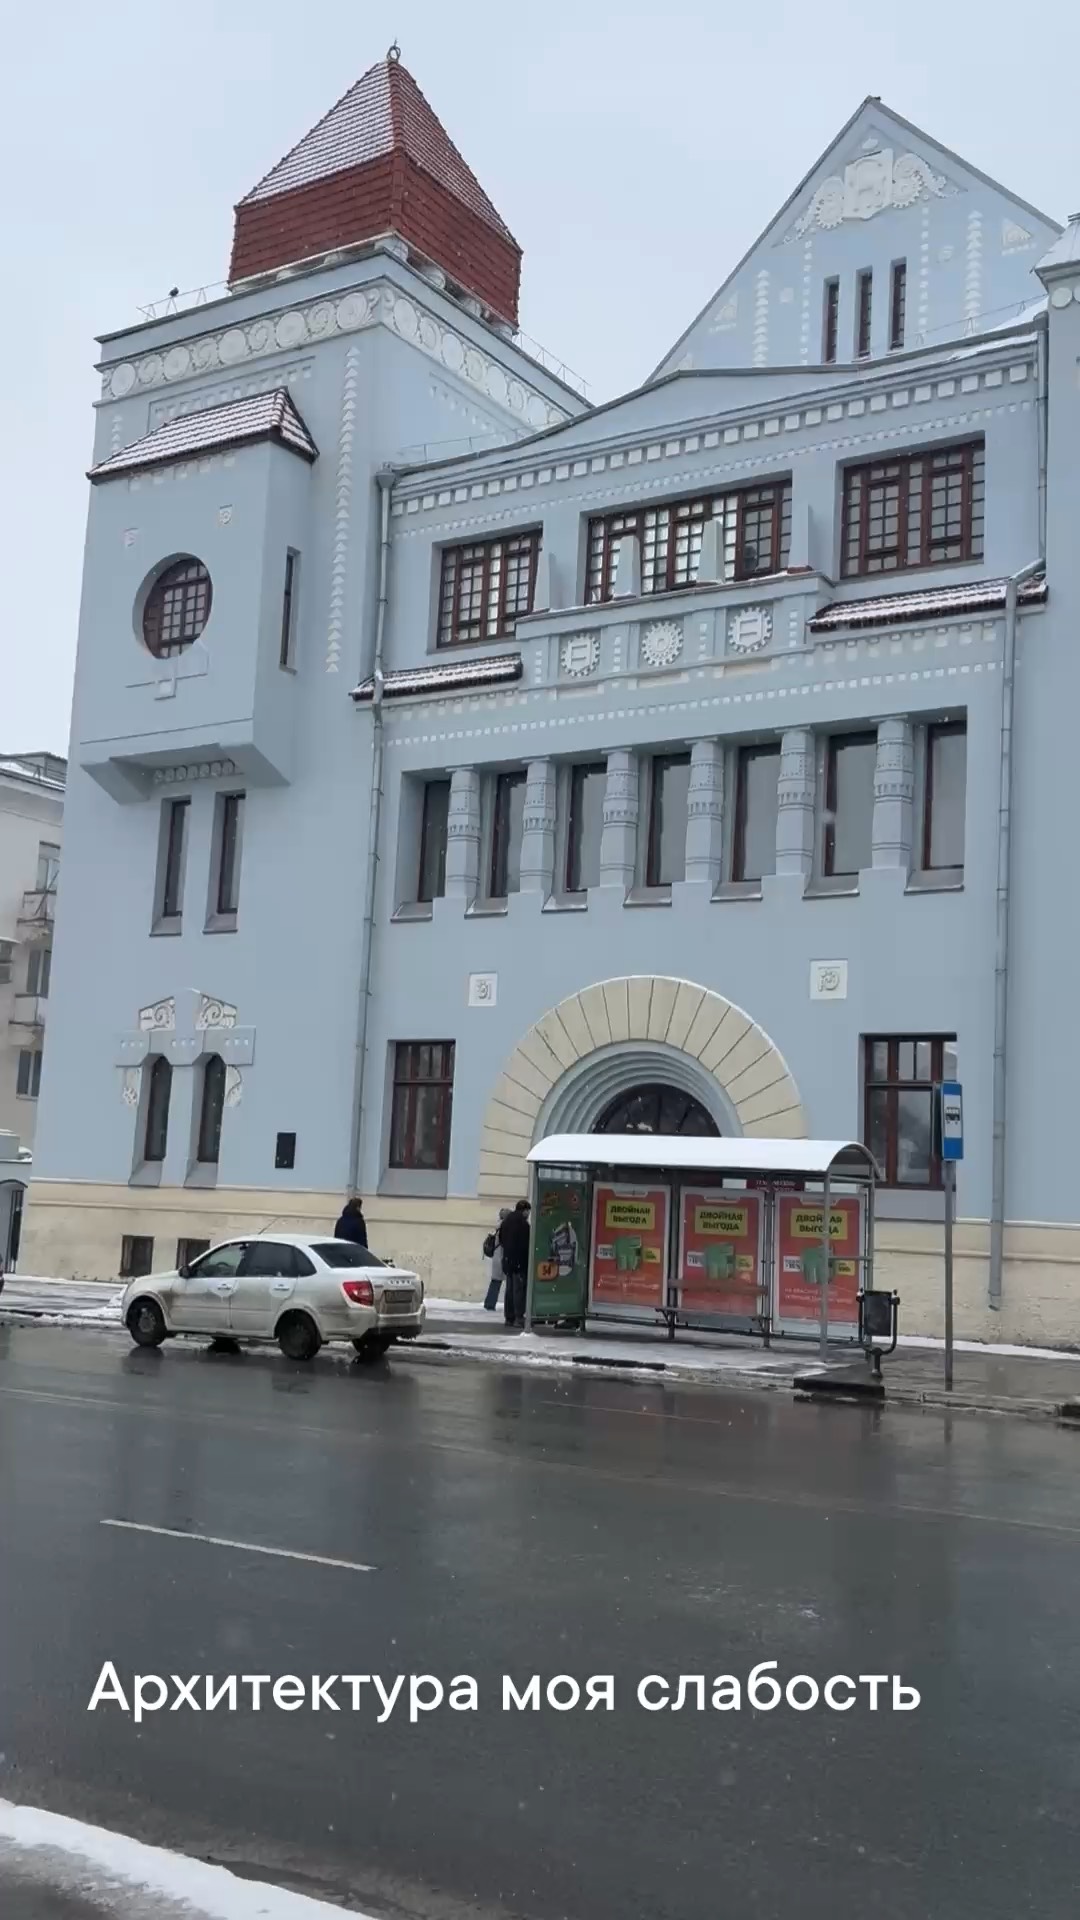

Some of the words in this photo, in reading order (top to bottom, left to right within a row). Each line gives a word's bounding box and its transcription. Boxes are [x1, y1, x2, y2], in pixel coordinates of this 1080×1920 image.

[610, 1204, 650, 1214] ДВОЙНАЯ
[612, 1215, 647, 1224] ВЫГОДА
[699, 1210, 744, 1222] ДВОЙНАЯ
[795, 1213, 843, 1224] ДВОЙАЯ
[702, 1221, 740, 1231] ВЫГОДА
